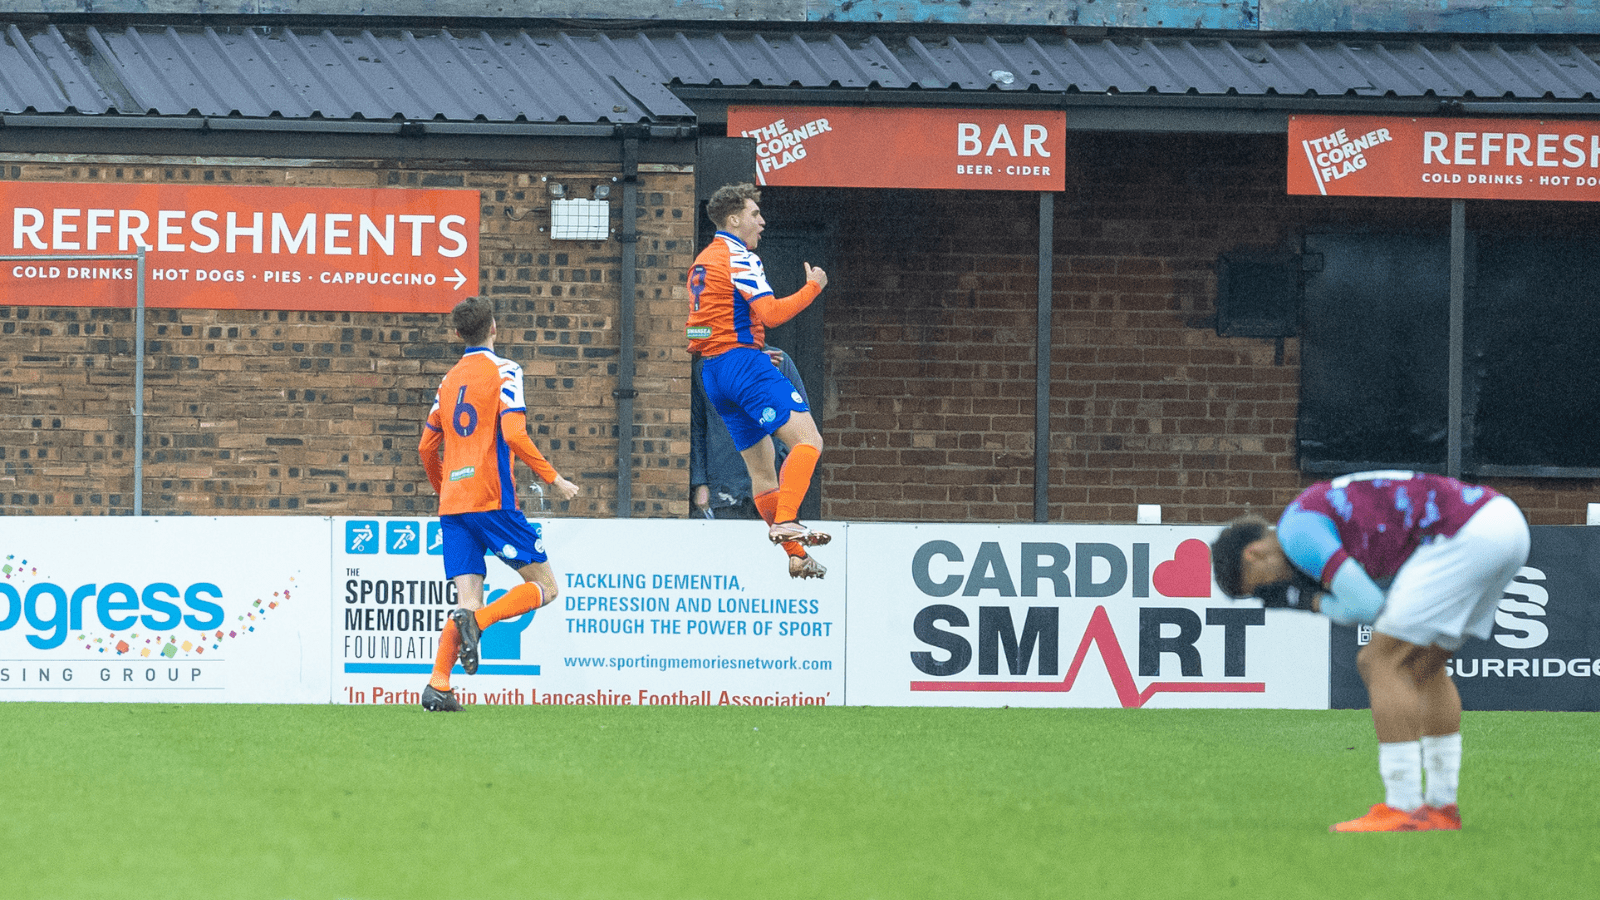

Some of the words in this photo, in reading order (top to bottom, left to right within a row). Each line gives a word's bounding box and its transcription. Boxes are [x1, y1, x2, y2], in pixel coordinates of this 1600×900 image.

[748, 118, 789, 144] THE
[756, 118, 833, 158] CORNER
[957, 122, 1051, 158] BAR
[1309, 128, 1349, 154] THE
[761, 143, 807, 173] FLAG
[1316, 128, 1393, 167] CORNER
[957, 164, 993, 175] BEER
[1007, 165, 1051, 176] CIDER
[1321, 153, 1368, 183] FLAG
[1422, 173, 1462, 184] COLD
[1468, 173, 1523, 185] DRINKS
[1540, 175, 1571, 186] HOT
[1576, 176, 1600, 187] DO
[13, 207, 468, 258] REFRESHMENTS
[12, 265, 61, 279] COLD
[67, 267, 134, 280] DRINKS
[152, 268, 189, 282] HOT
[196, 270, 246, 283] DOGS
[264, 271, 302, 284] PIES
[320, 271, 436, 286] CAPPUCCINO
[690, 264, 707, 312] 9
[452, 385, 478, 437] 6
[346, 567, 360, 577] THE
[565, 573, 646, 589] TACKLING
[653, 574, 745, 592] DEMENTIA,
[345, 579, 459, 605] SPORTING
[565, 596, 670, 613] DEPRESSION
[676, 598, 712, 613] AND
[718, 598, 819, 614] LONELINESS
[566, 618, 645, 634] THROUGH
[650, 619, 681, 635] THE
[687, 620, 747, 636] POWER
[753, 621, 773, 636] OF
[778, 621, 833, 637] SPORT
[344, 635, 432, 660] FOUNDATI
[0, 668, 73, 682] SING
[100, 668, 202, 682] GROUP
[564, 655, 833, 671] www.sportingmemoriesnetwork.com
[484, 688, 525, 705] with
[532, 688, 631, 706] Lancashire
[638, 689, 711, 706] Football
